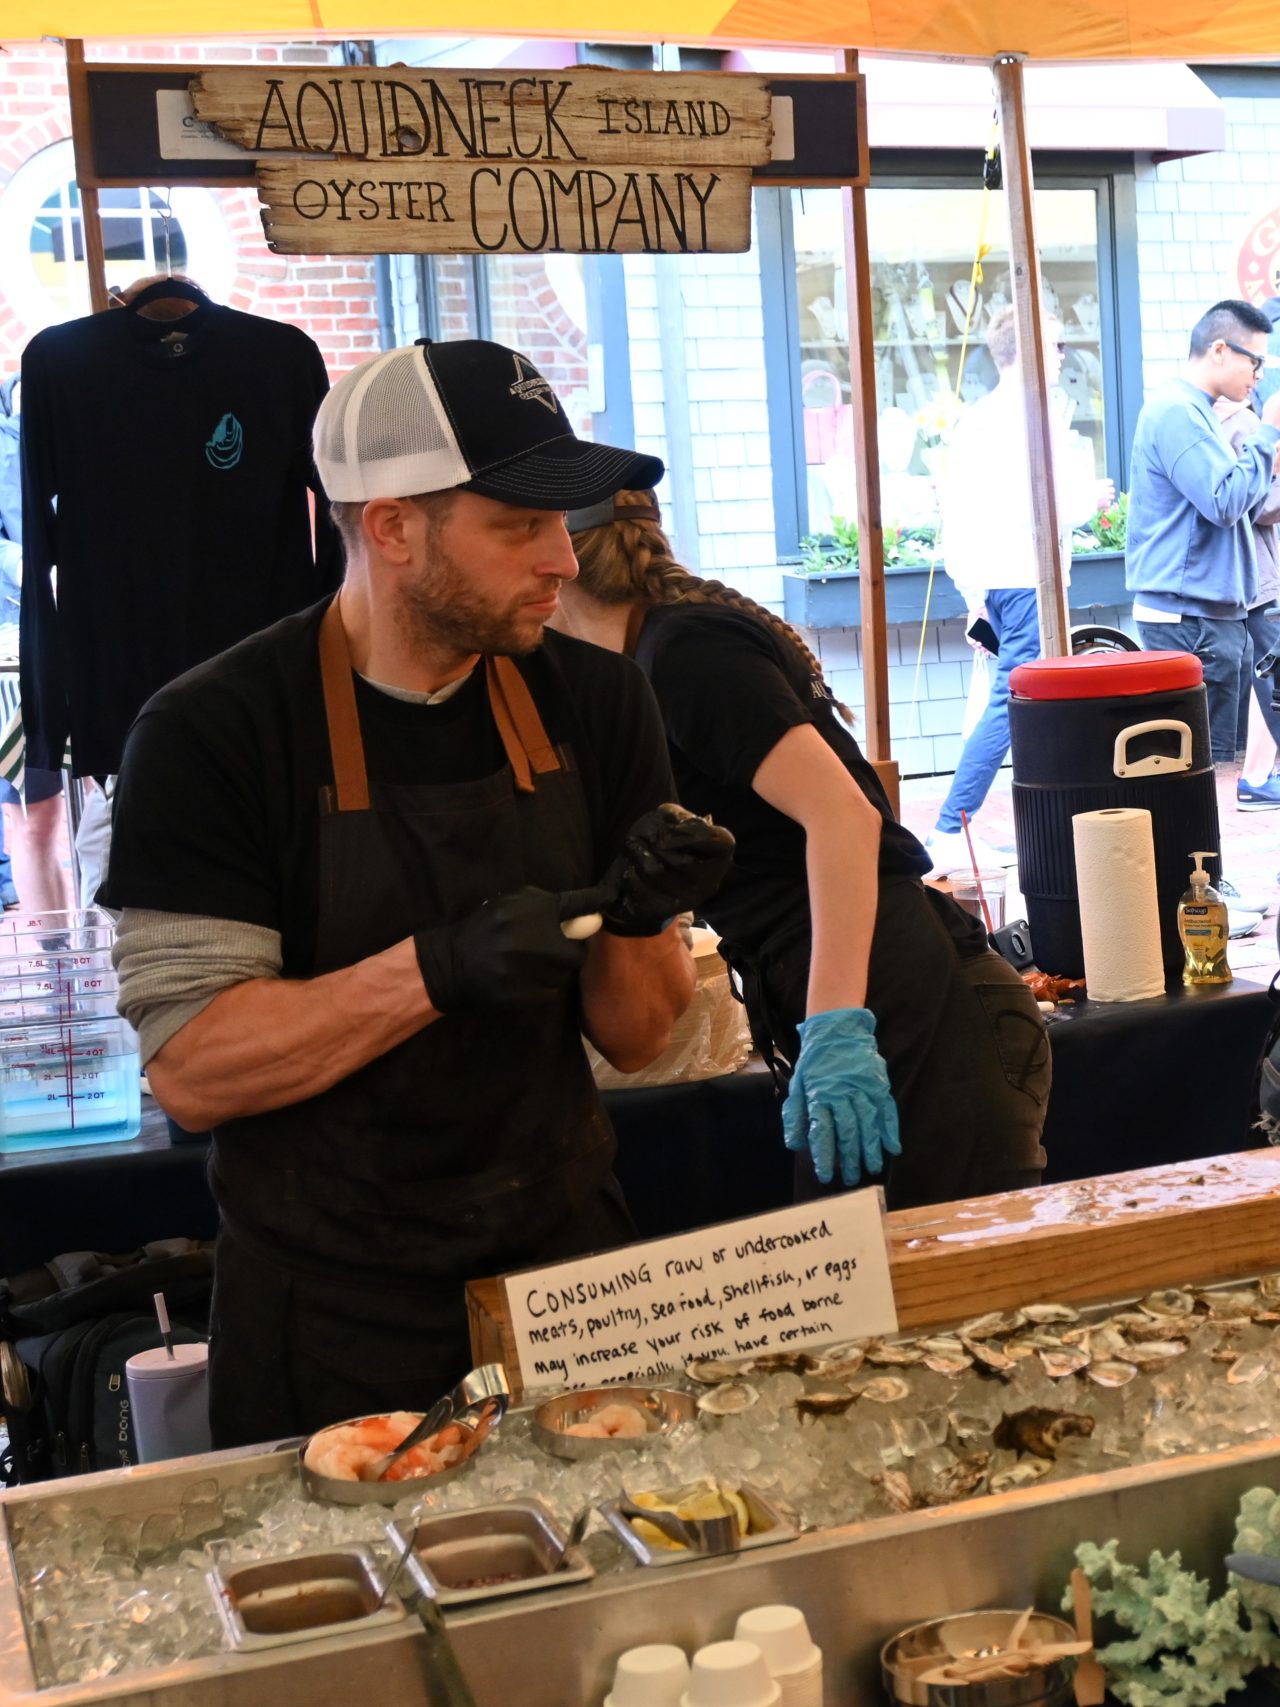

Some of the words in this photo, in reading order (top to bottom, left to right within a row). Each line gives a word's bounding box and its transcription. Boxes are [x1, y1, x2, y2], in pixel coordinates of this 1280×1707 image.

[255, 77, 588, 160] AQUIDNECK
[597, 97, 731, 137] ISLAND
[293, 178, 456, 223] OYSTER
[469, 166, 721, 253] COMPANY
[526, 1262, 653, 1318] CONSUMING
[665, 1256, 704, 1278] raw
[712, 1248, 726, 1264] or
[735, 1220, 833, 1260] undercooked
[528, 1318, 584, 1345] meats,
[586, 1306, 648, 1339] poultry,
[805, 1266, 819, 1281] or
[824, 1257, 858, 1282] eggs
[573, 1341, 639, 1367] increase
[691, 1320, 724, 1341] risk
[735, 1312, 750, 1330] of
[759, 1302, 795, 1323] food
[802, 1292, 843, 1312] borne
[735, 1334, 769, 1354] have
[780, 1321, 833, 1343] certain
